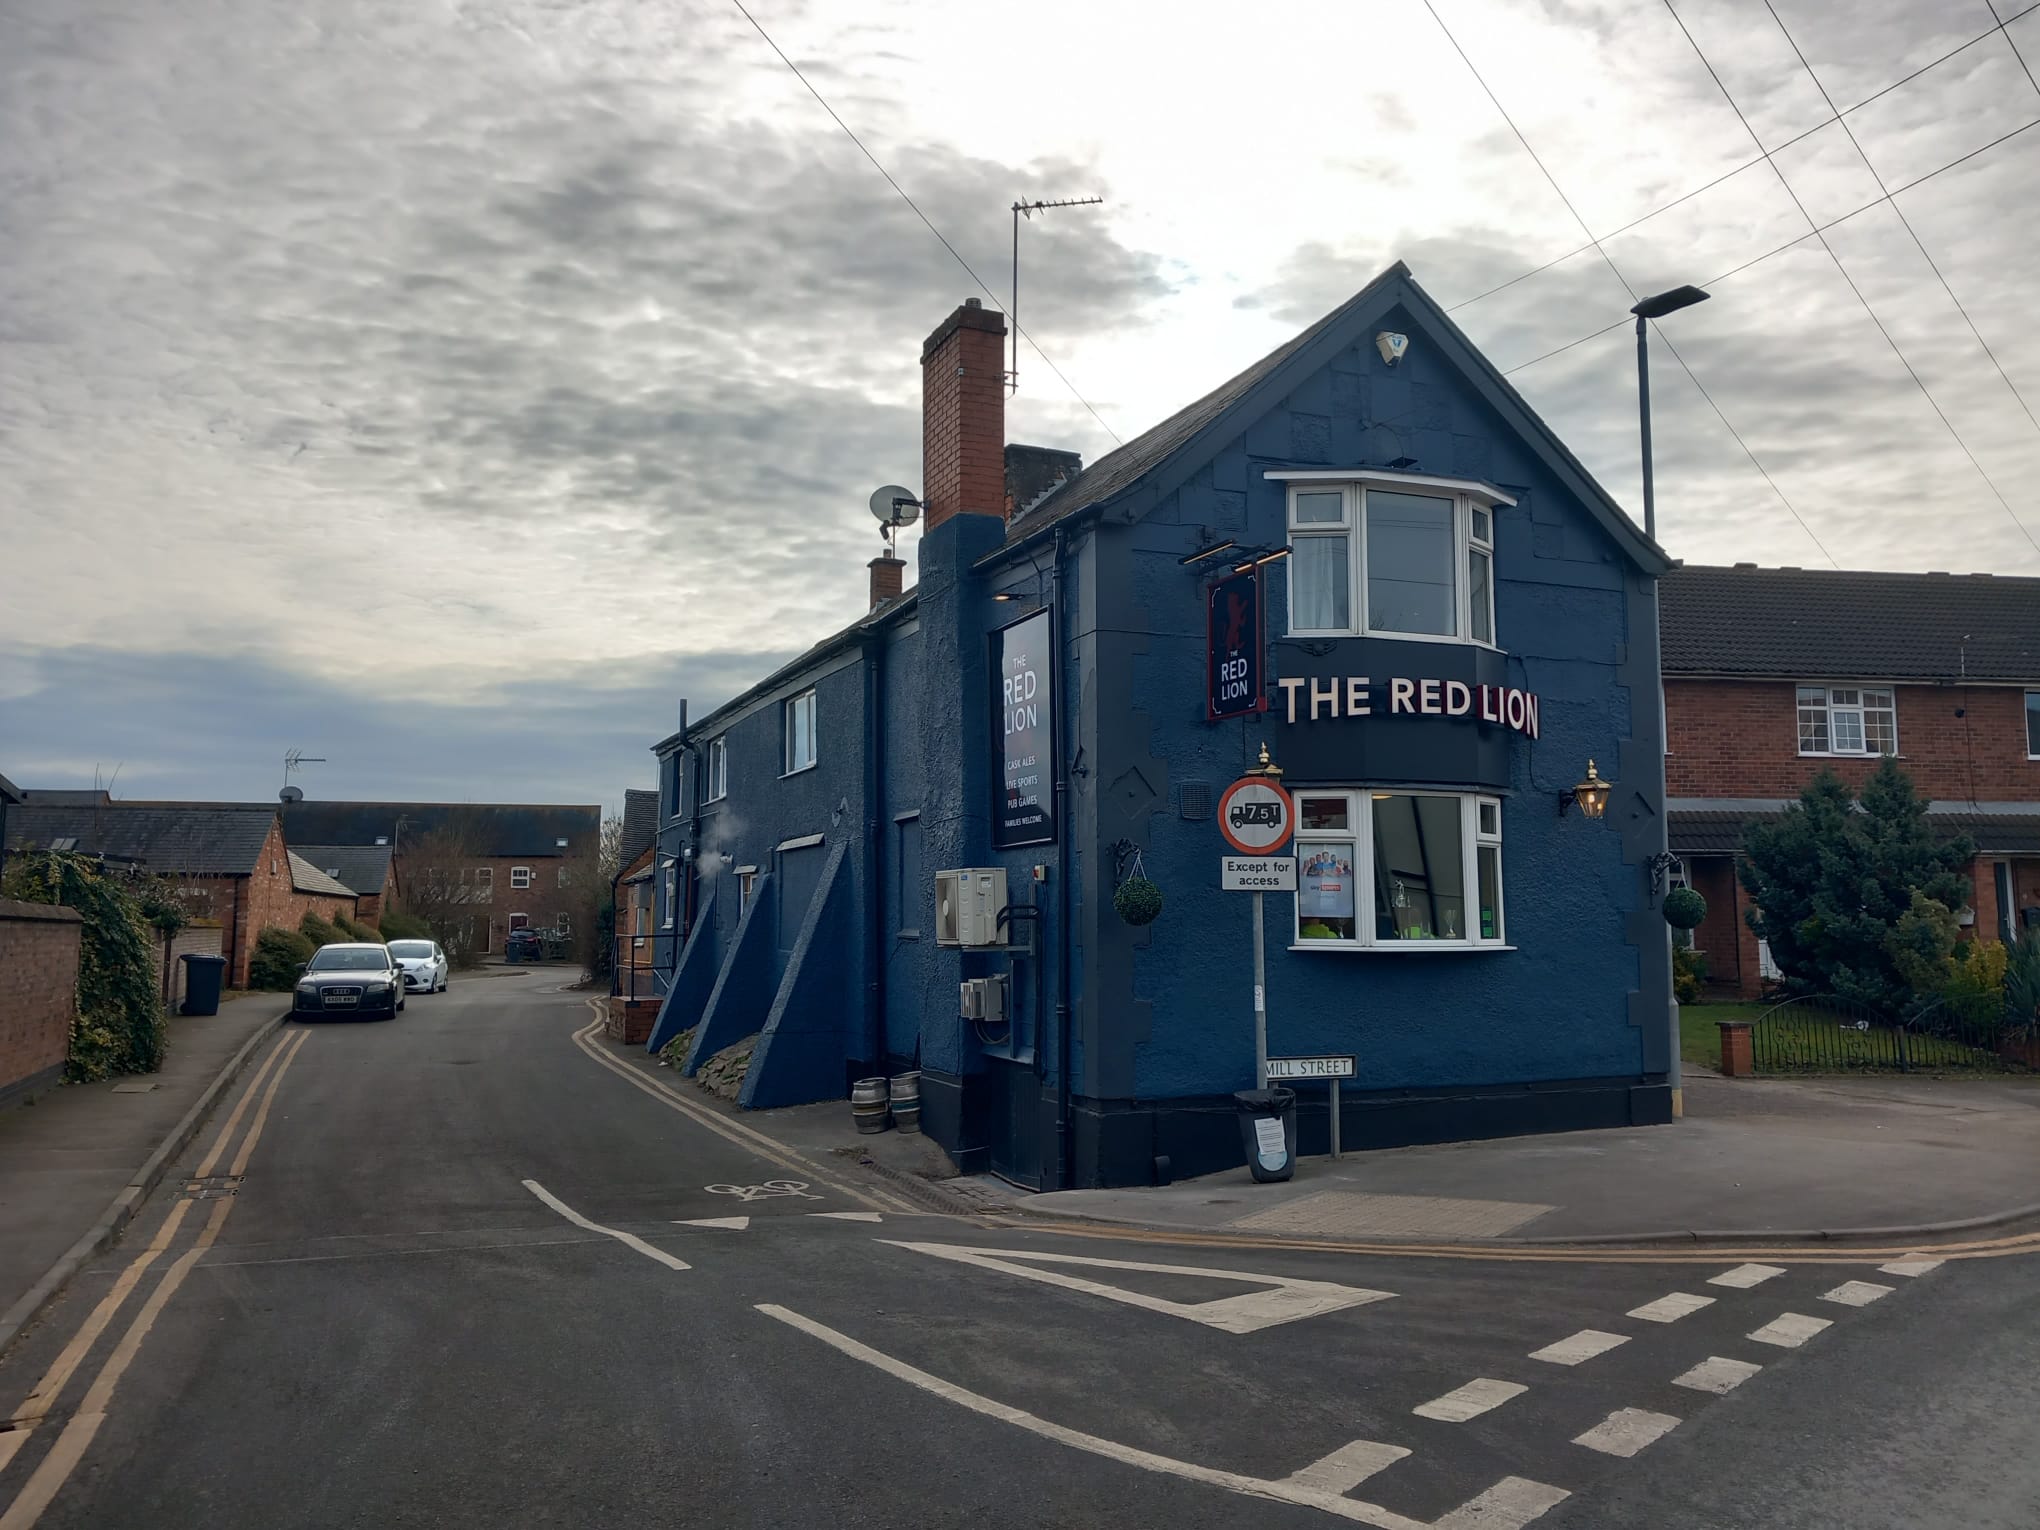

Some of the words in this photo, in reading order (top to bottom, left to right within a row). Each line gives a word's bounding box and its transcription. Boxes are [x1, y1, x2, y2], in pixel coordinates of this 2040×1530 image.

[1012, 654, 1027, 669] THE
[1221, 658, 1248, 682] RED
[1003, 670, 1037, 707] RED
[1221, 680, 1248, 700] LION
[1278, 677, 1371, 724] THE
[1389, 677, 1471, 716] RED
[1479, 684, 1539, 740] LION
[1004, 703, 1037, 735] LION
[1007, 759, 1021, 771] CASK
[1021, 755, 1036, 767] ALES
[1006, 779, 1017, 791] LIVE
[1017, 774, 1038, 788] SPORTS
[1007, 798, 1018, 810] PUB
[1018, 794, 1038, 808] GAMES
[1021, 814, 1042, 825] WELCOME
[1227, 861, 1268, 874] Except
[1273, 861, 1290, 872] for
[1239, 877, 1280, 886] access
[1265, 1061, 1294, 1076] MILL
[1300, 1060, 1349, 1075] STREET
